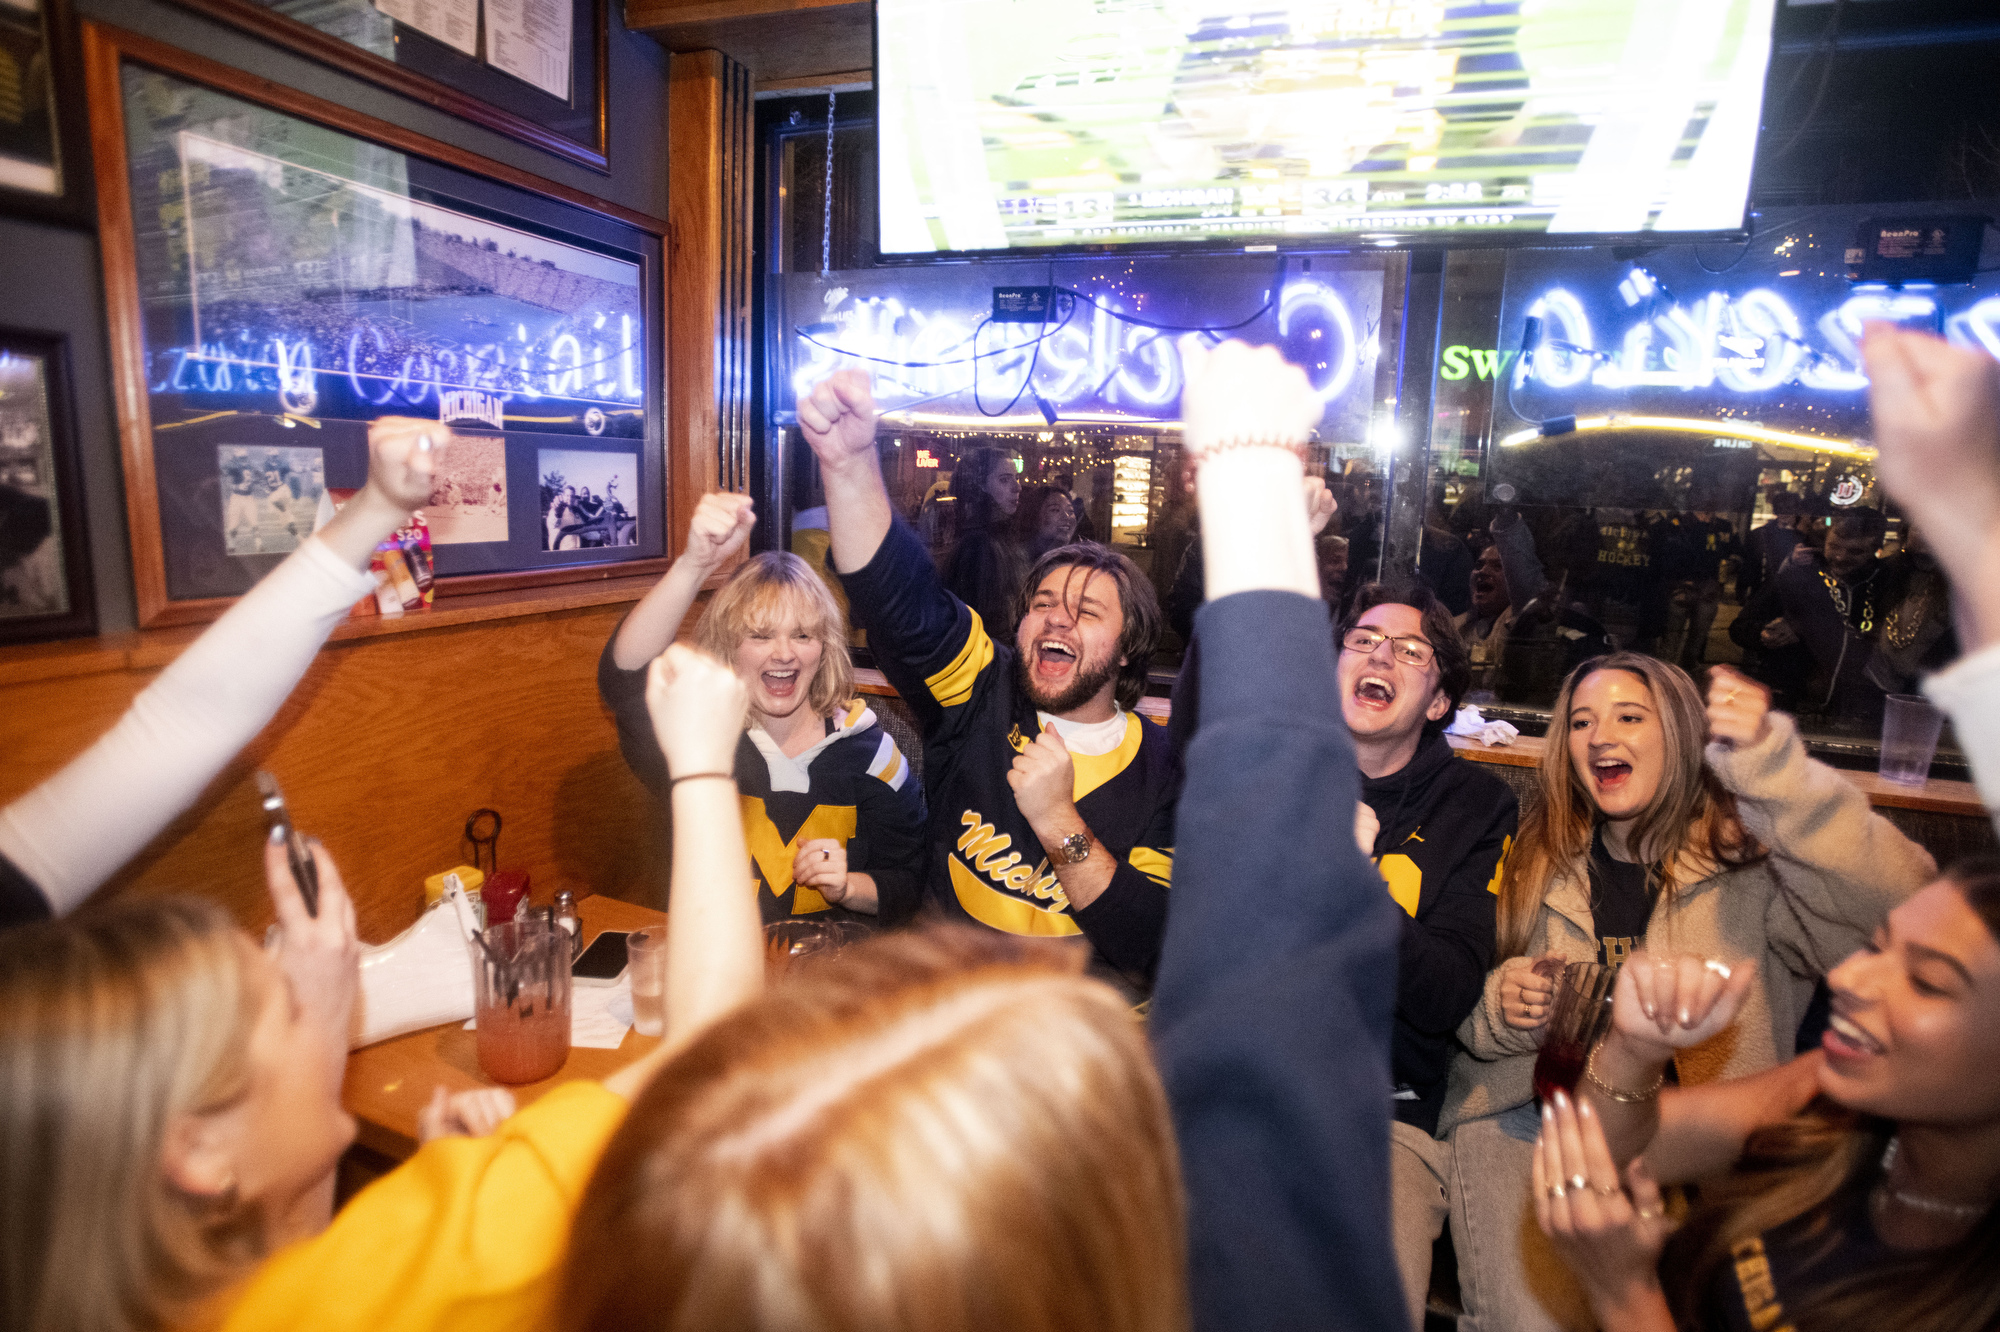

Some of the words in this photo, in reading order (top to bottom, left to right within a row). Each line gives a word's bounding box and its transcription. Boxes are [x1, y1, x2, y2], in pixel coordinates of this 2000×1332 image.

[439, 390, 504, 430] MICHIGAN
[1597, 549, 1651, 567] HOCKEY
[739, 794, 858, 915] M
[957, 809, 1071, 913] Michig
